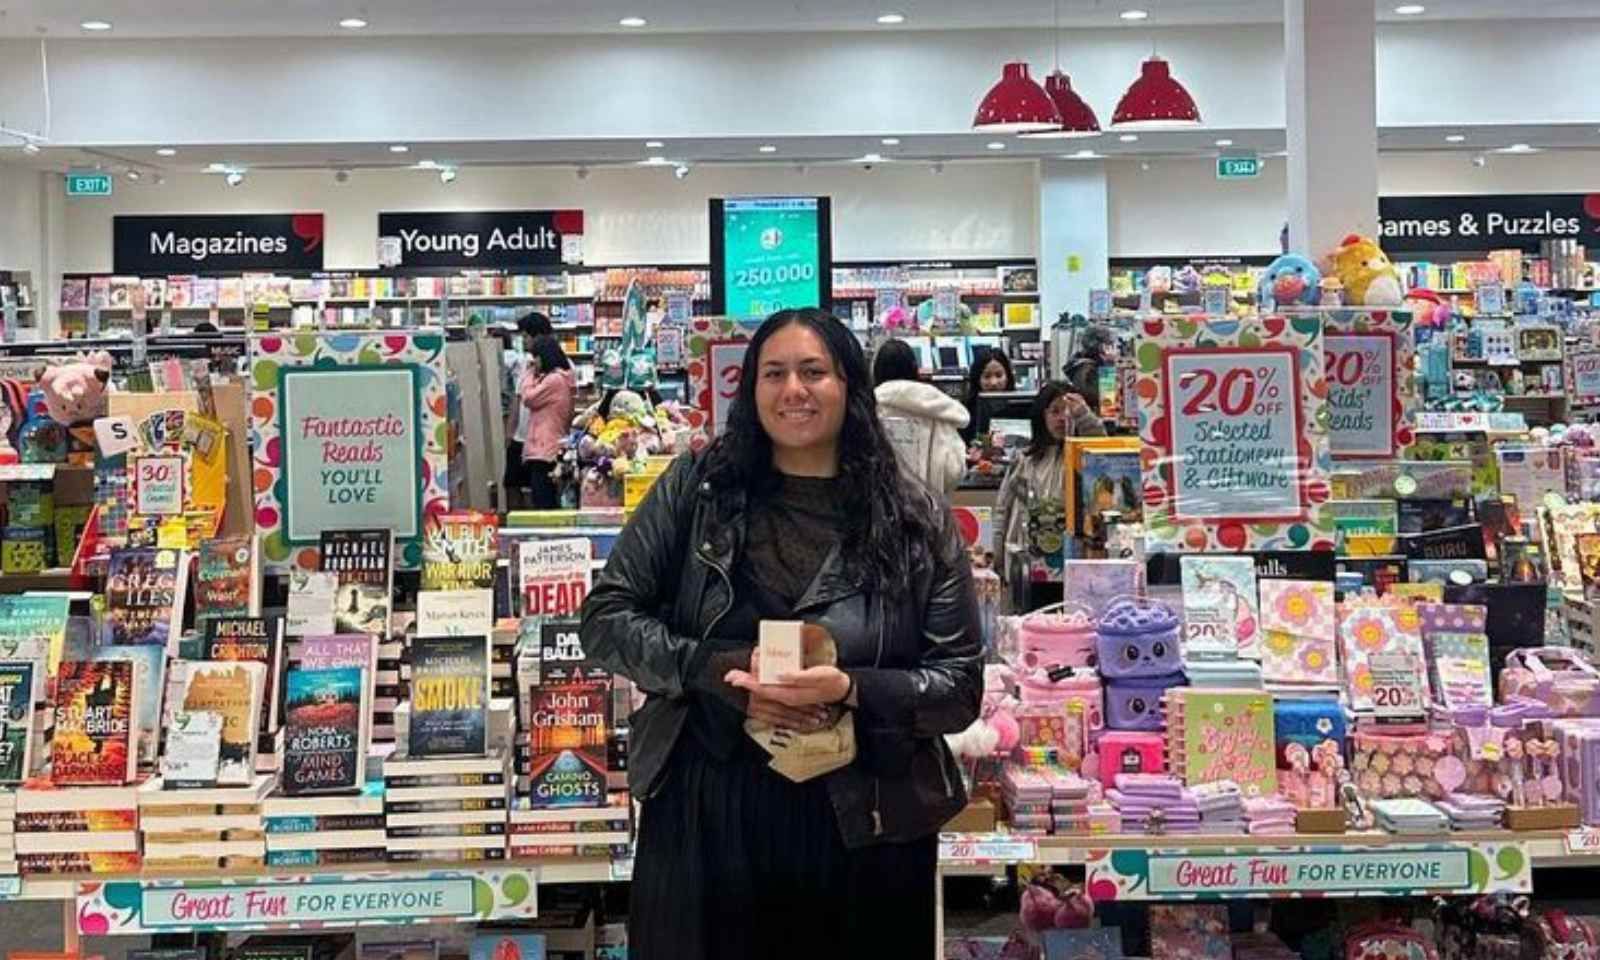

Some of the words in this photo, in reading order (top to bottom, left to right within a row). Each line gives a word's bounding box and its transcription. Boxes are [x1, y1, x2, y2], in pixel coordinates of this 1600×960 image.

[1459, 214, 1479, 235] &
[1487, 211, 1581, 235] Puzzles
[150, 231, 288, 260] Magazines
[399, 228, 479, 257] Young
[486, 226, 557, 251] Adult
[720, 365, 742, 398] 3
[1254, 402, 1283, 415] OFF
[110, 422, 127, 439] S
[301, 413, 405, 439] Fantastic
[1194, 419, 1273, 442] Selected
[322, 439, 384, 463] Reads
[1185, 443, 1286, 469] Stationery
[320, 468, 384, 485] YOU'LL
[1183, 470, 1201, 489] &
[1206, 466, 1289, 491] Giftware
[328, 487, 376, 503] LOVE
[325, 541, 385, 556] MICHAEL
[523, 551, 586, 565] PATTERSON
[526, 581, 586, 618] DEAD
[216, 620, 268, 637] MICHAEL
[305, 645, 336, 658] ALL
[337, 642, 369, 656] THAT
[547, 692, 589, 709] John
[56, 705, 113, 721] STUART
[533, 710, 604, 727] Grisham
[292, 734, 352, 751] ROBERTS
[302, 754, 343, 769] MIND
[293, 766, 347, 784] GAMES
[545, 771, 592, 782] CAMINO
[537, 782, 600, 798] GHOSTS
[1175, 861, 1239, 889] Great
[1247, 858, 1289, 885] Fun
[1297, 864, 1336, 880] FOR
[1342, 862, 1441, 879] EVERYONE
[171, 892, 235, 919] Great
[244, 891, 287, 917] Fun
[297, 895, 335, 912] FOR
[342, 890, 443, 910] EVERYONE
